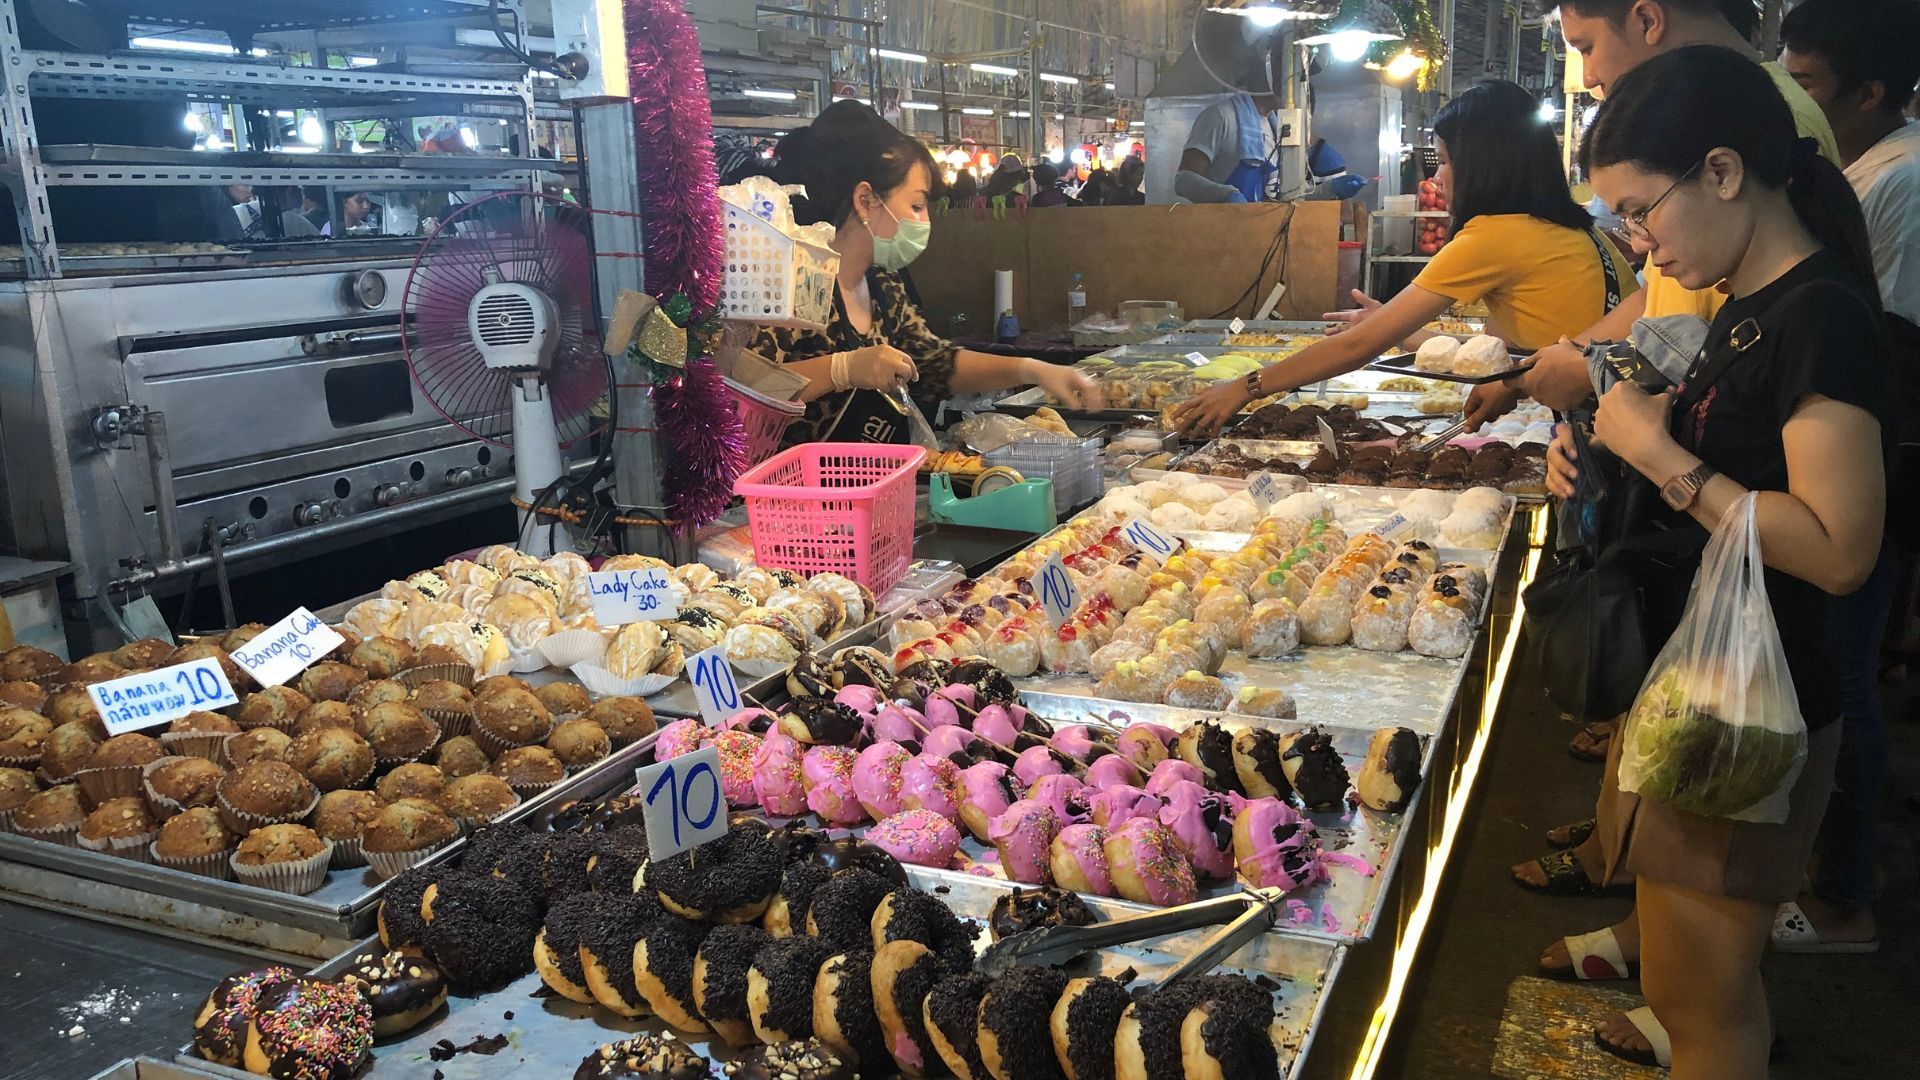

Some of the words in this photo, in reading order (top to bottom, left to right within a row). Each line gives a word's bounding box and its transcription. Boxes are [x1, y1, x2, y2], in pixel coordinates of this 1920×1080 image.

[1607, 291, 1619, 309] S
[589, 575, 629, 602] Lady
[630, 570, 668, 590] Cake
[235, 632, 300, 670] Banana
[291, 614, 322, 637] Cake
[98, 681, 172, 706] Banana
[695, 654, 738, 713] 10
[646, 761, 720, 847] 10
